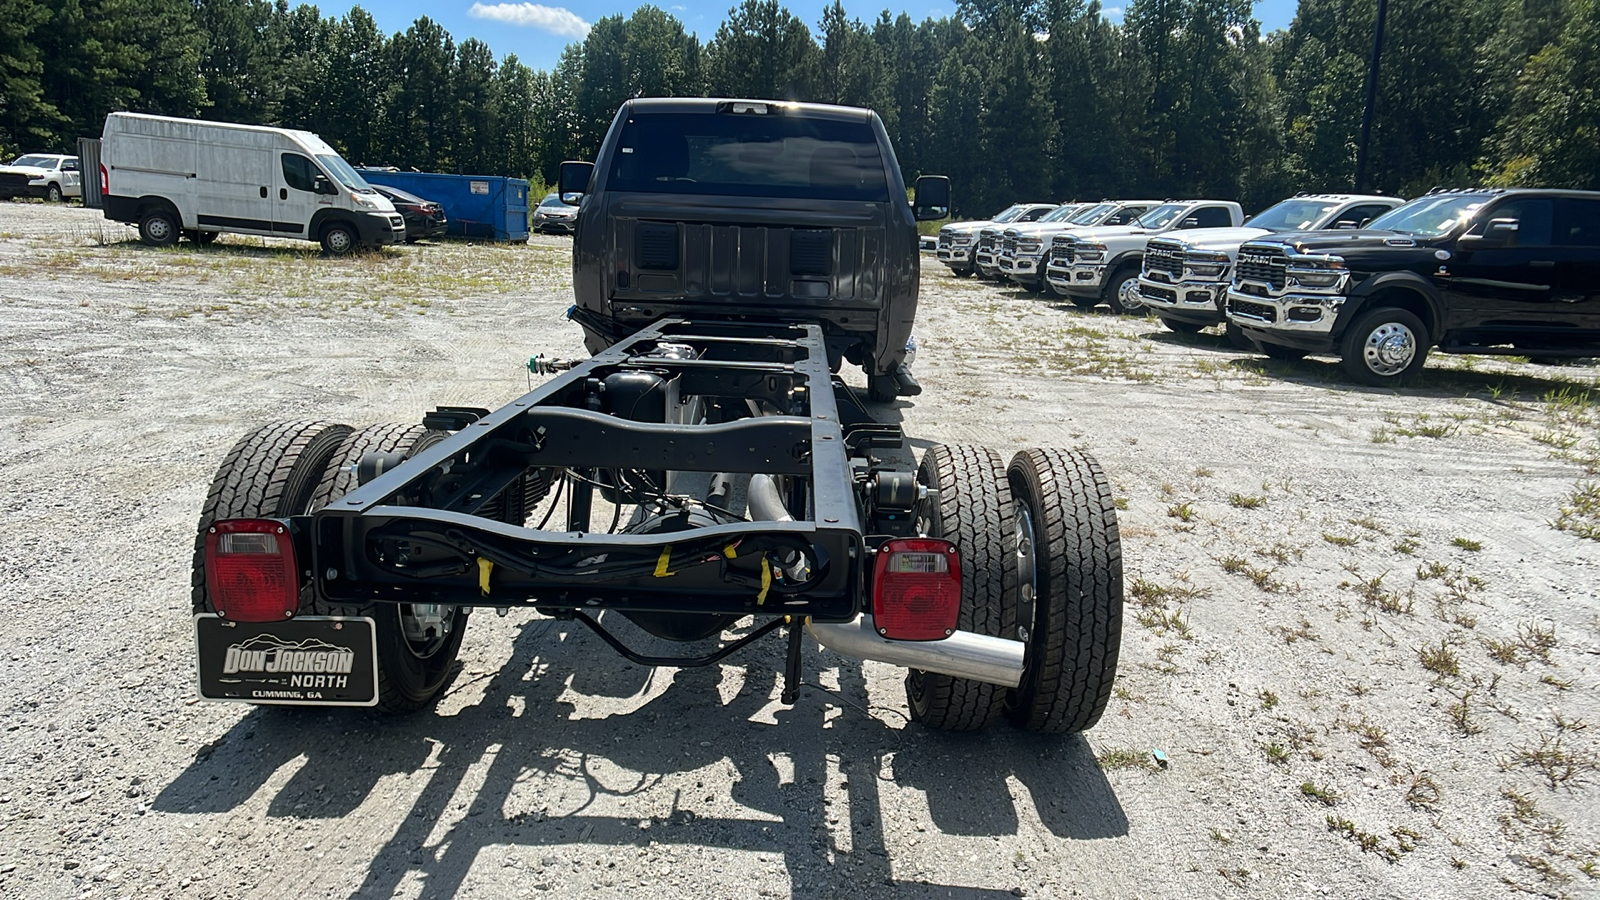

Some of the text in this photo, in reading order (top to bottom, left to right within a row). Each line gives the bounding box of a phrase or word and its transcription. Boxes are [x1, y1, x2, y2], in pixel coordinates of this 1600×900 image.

[1243, 254, 1270, 265] RAM
[223, 647, 355, 674] DON JACKSON
[290, 674, 348, 688] NORTH
[252, 690, 323, 699] CUMMING, GA
